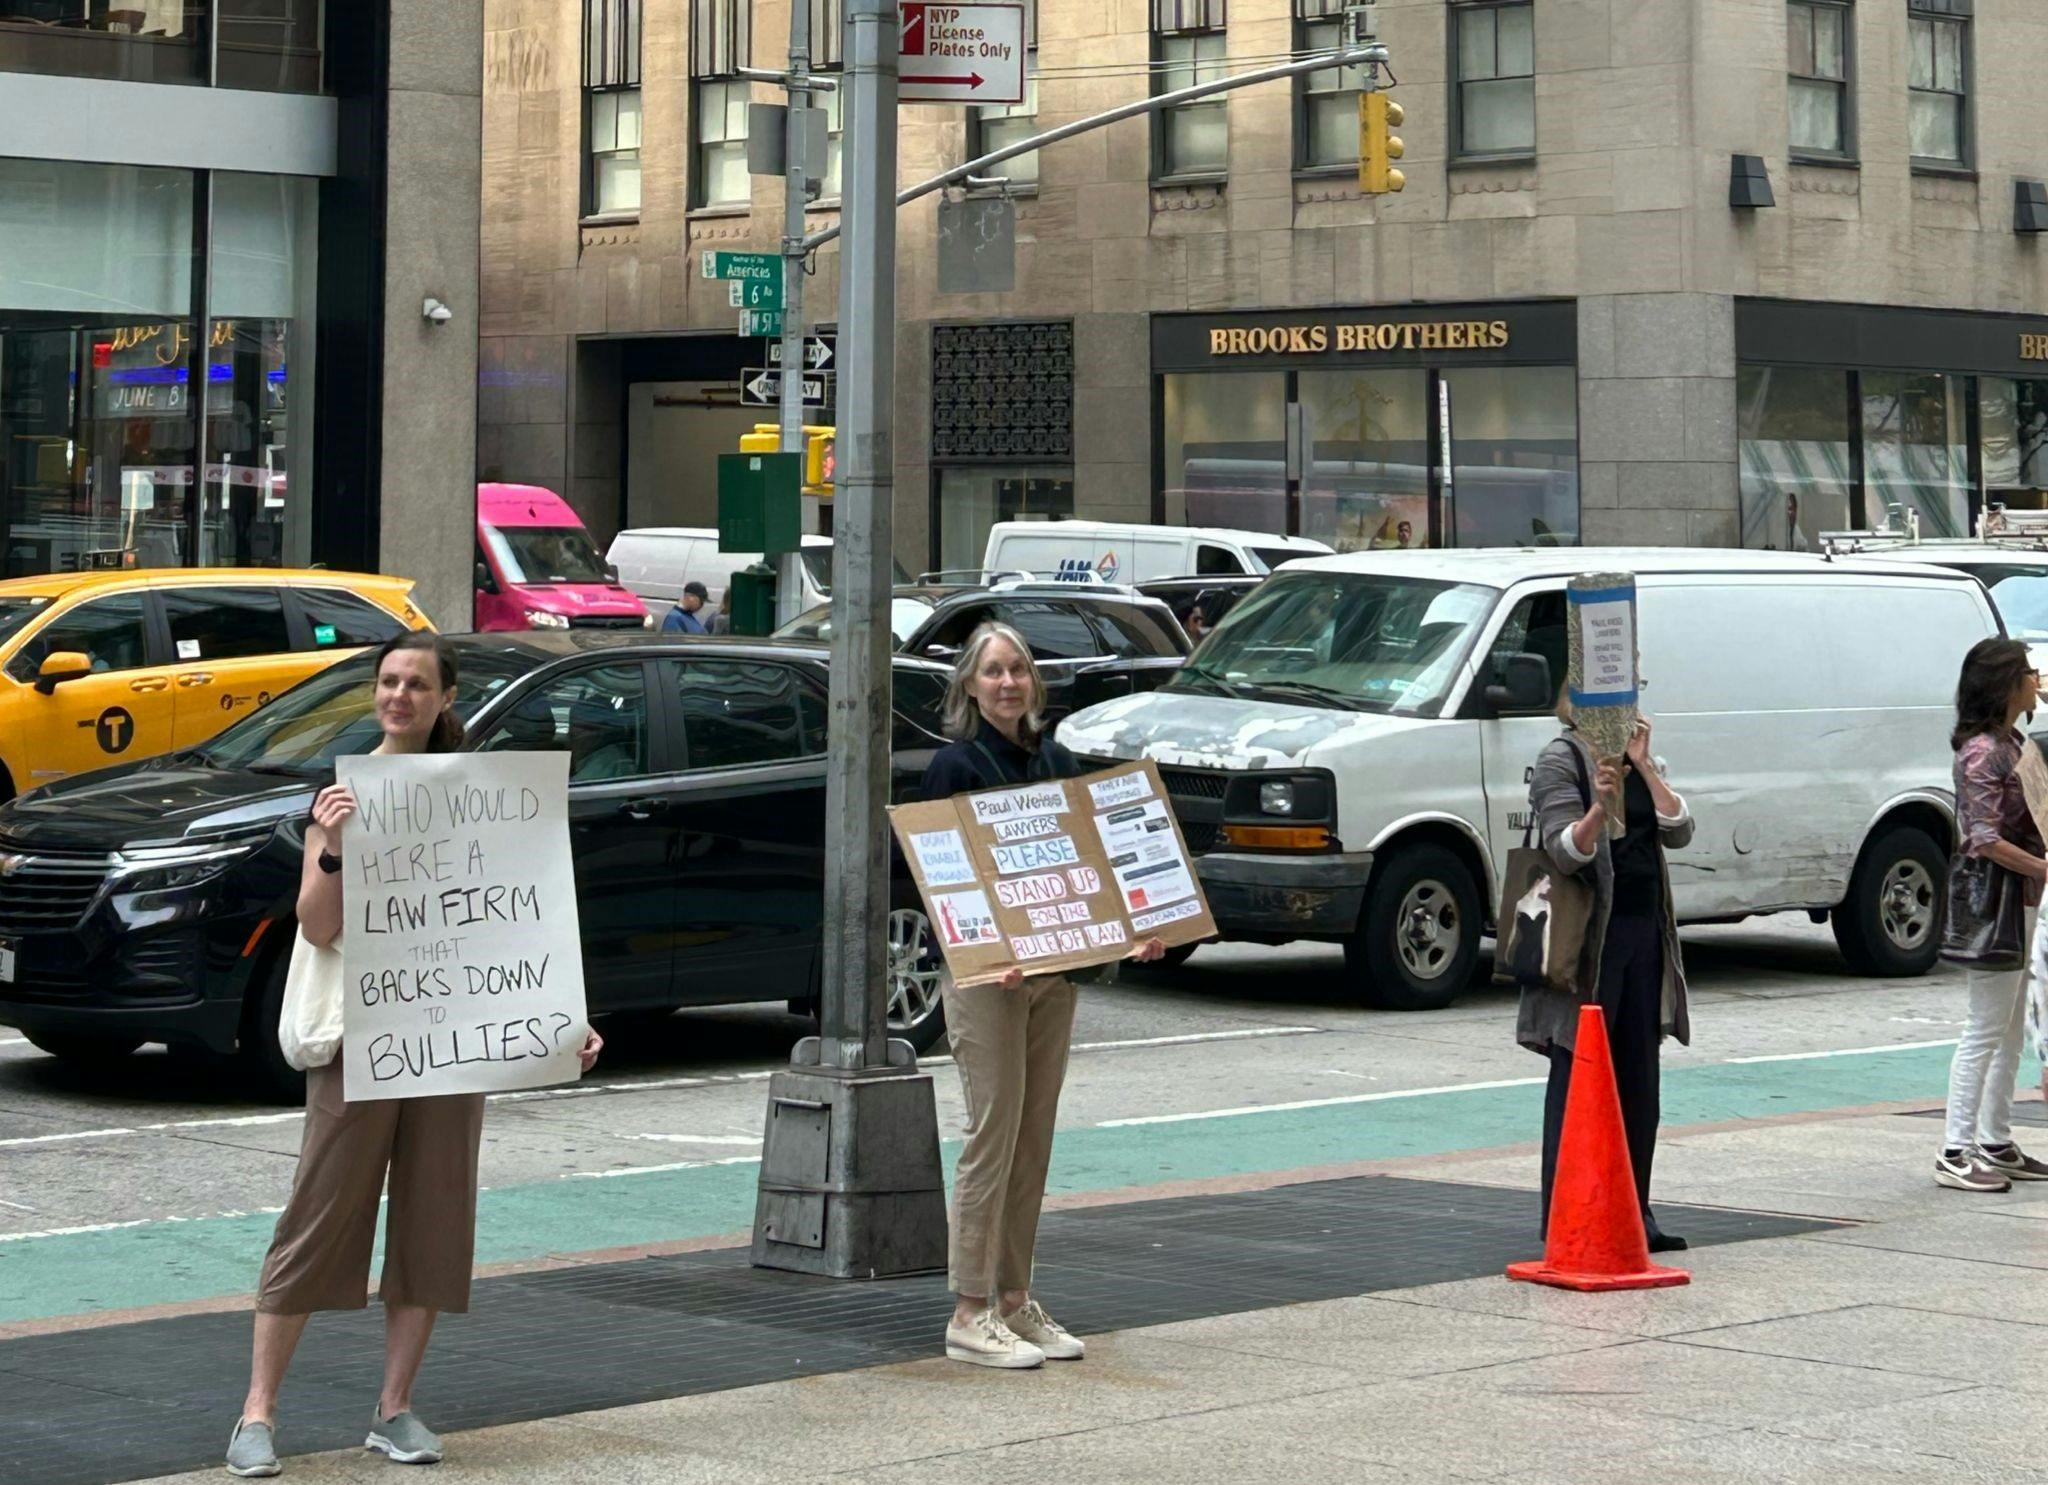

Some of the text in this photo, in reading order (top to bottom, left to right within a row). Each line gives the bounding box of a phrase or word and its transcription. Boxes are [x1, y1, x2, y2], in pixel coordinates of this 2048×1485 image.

[930, 9, 960, 24] NYP
[930, 25, 985, 41] License
[930, 42, 1011, 61] Plates Only
[751, 285, 759, 304] 6
[1209, 320, 1509, 354] BROOKS BROTHERS
[113, 387, 155, 409] JUNE
[757, 381, 816, 397] ONE AY
[105, 715, 126, 749] T
[350, 777, 540, 835] WHO WOULD
[975, 792, 1063, 817] Paul Weiss
[996, 815, 1059, 840] LAWYERS
[361, 839, 485, 886] HIRE A
[996, 838, 1076, 869] PLEASE
[998, 876, 1065, 905] STAND
[1068, 869, 1097, 892] UP
[365, 885, 541, 934] LAW FIRM
[1060, 903, 1088, 920] THE
[408, 937, 467, 962] THAT
[1012, 923, 1123, 957] RULE OF LAW
[360, 953, 549, 1007] BACKS DOWN
[424, 1006, 447, 1025] TO
[368, 1012, 572, 1081] BULLIES?
